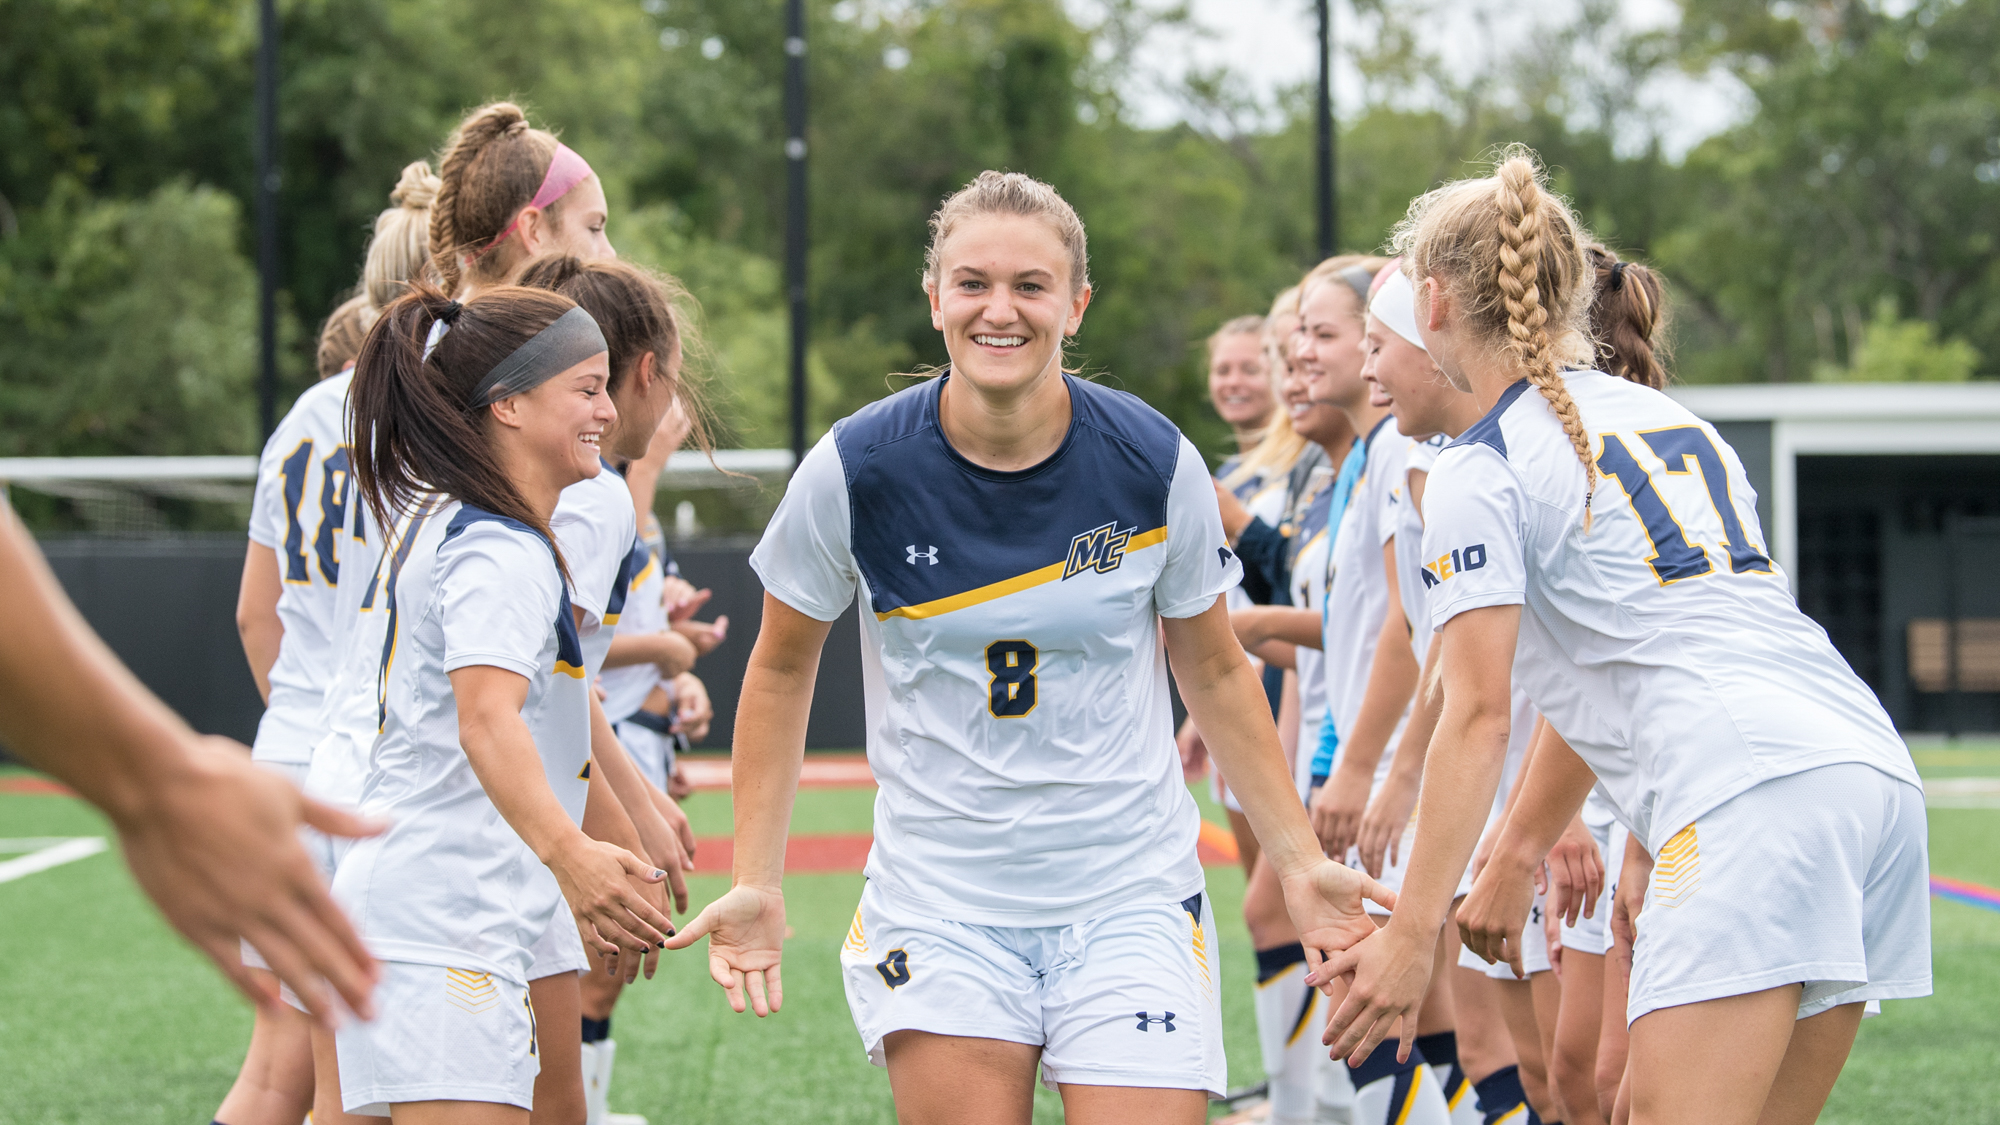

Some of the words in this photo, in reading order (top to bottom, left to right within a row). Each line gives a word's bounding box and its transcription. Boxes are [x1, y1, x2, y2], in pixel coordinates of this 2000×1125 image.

[279, 437, 354, 588] 18
[1061, 521, 1133, 582] MC
[1597, 424, 1777, 586] 17
[984, 639, 1039, 719] 8
